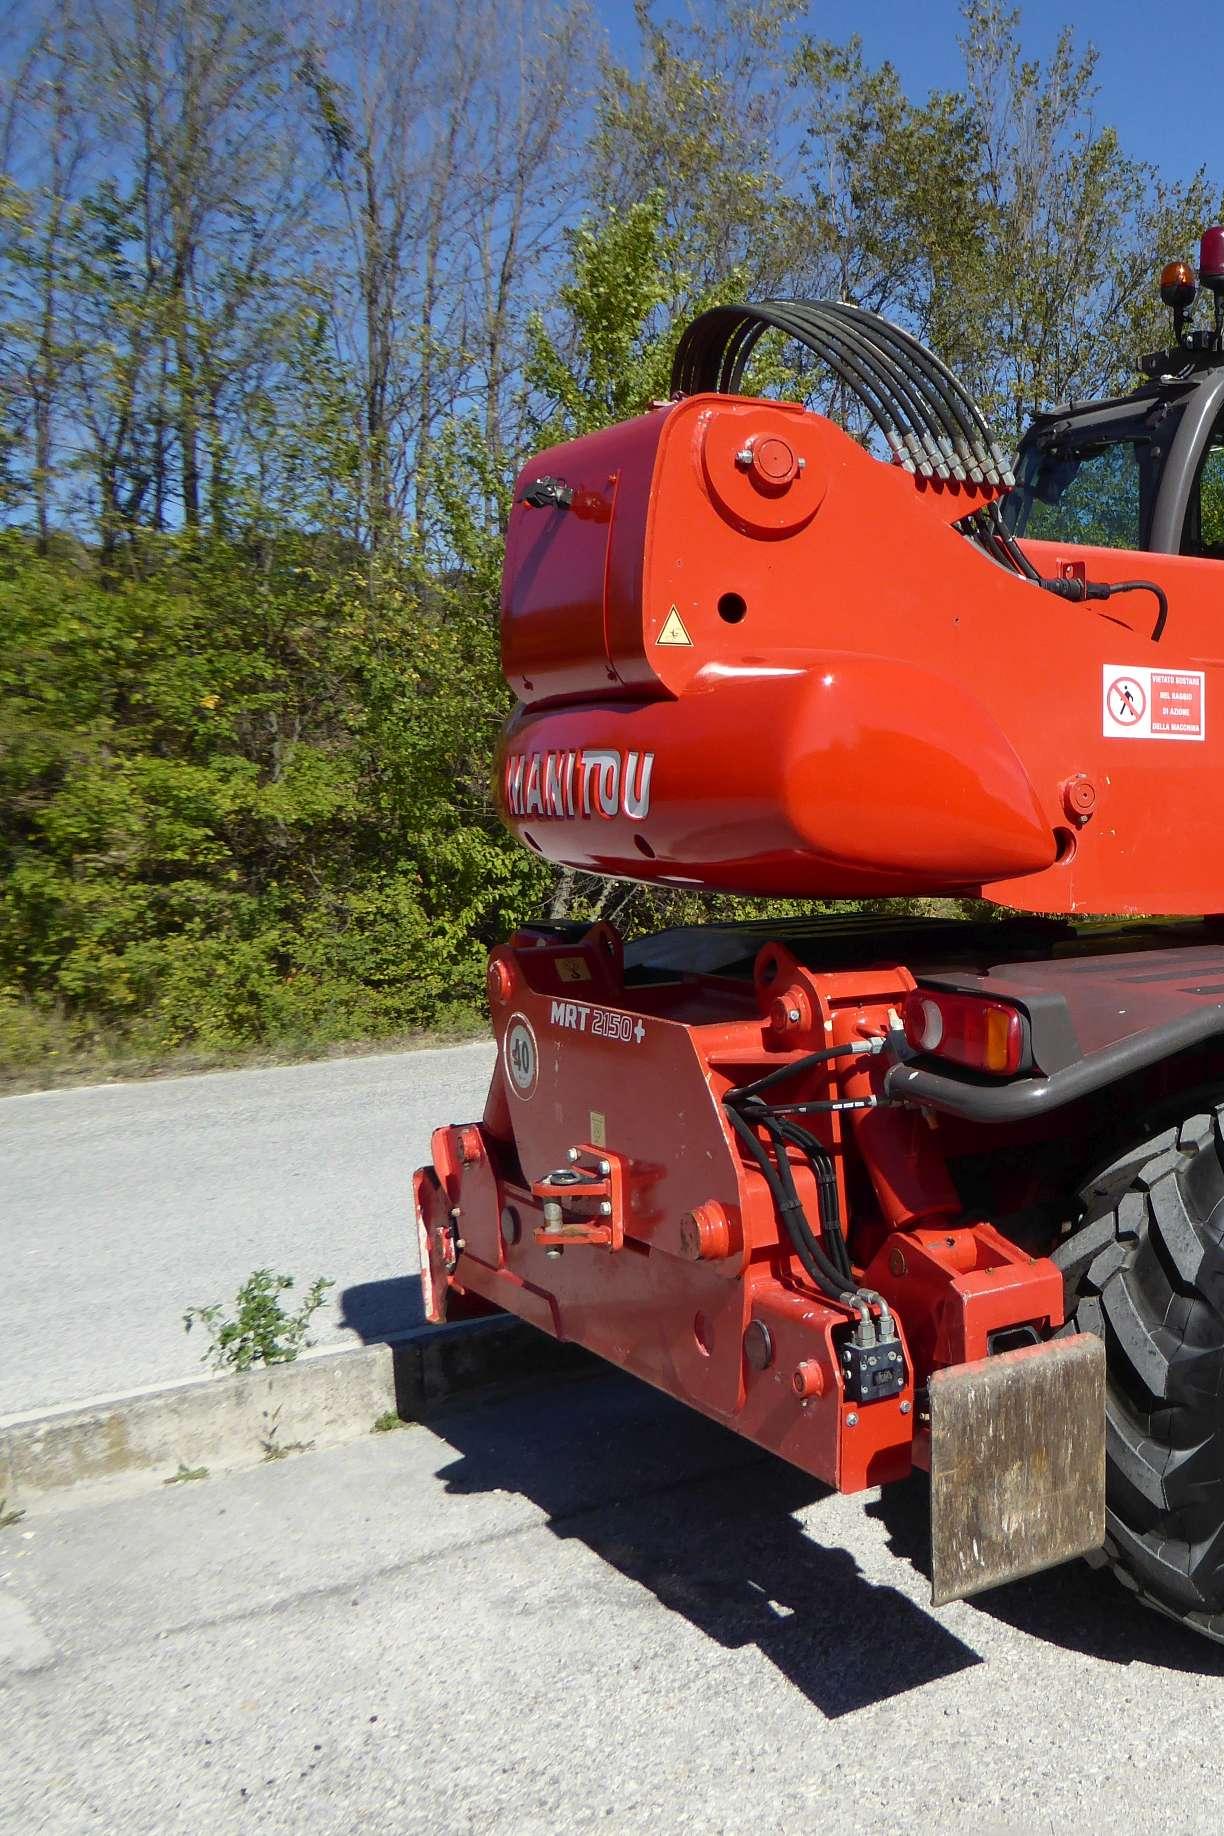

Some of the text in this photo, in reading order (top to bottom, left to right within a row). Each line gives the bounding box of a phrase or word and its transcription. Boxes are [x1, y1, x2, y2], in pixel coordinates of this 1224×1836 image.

[1152, 675, 1175, 685] VIETATO
[1171, 692, 1193, 701] RAGGIO
[1162, 707, 1190, 716] DI AZIONE
[1152, 723, 1170, 731] DELLA
[506, 749, 655, 820] MANITOU
[551, 1001, 646, 1044] MRT 2150+
[511, 1038, 530, 1074] 40
